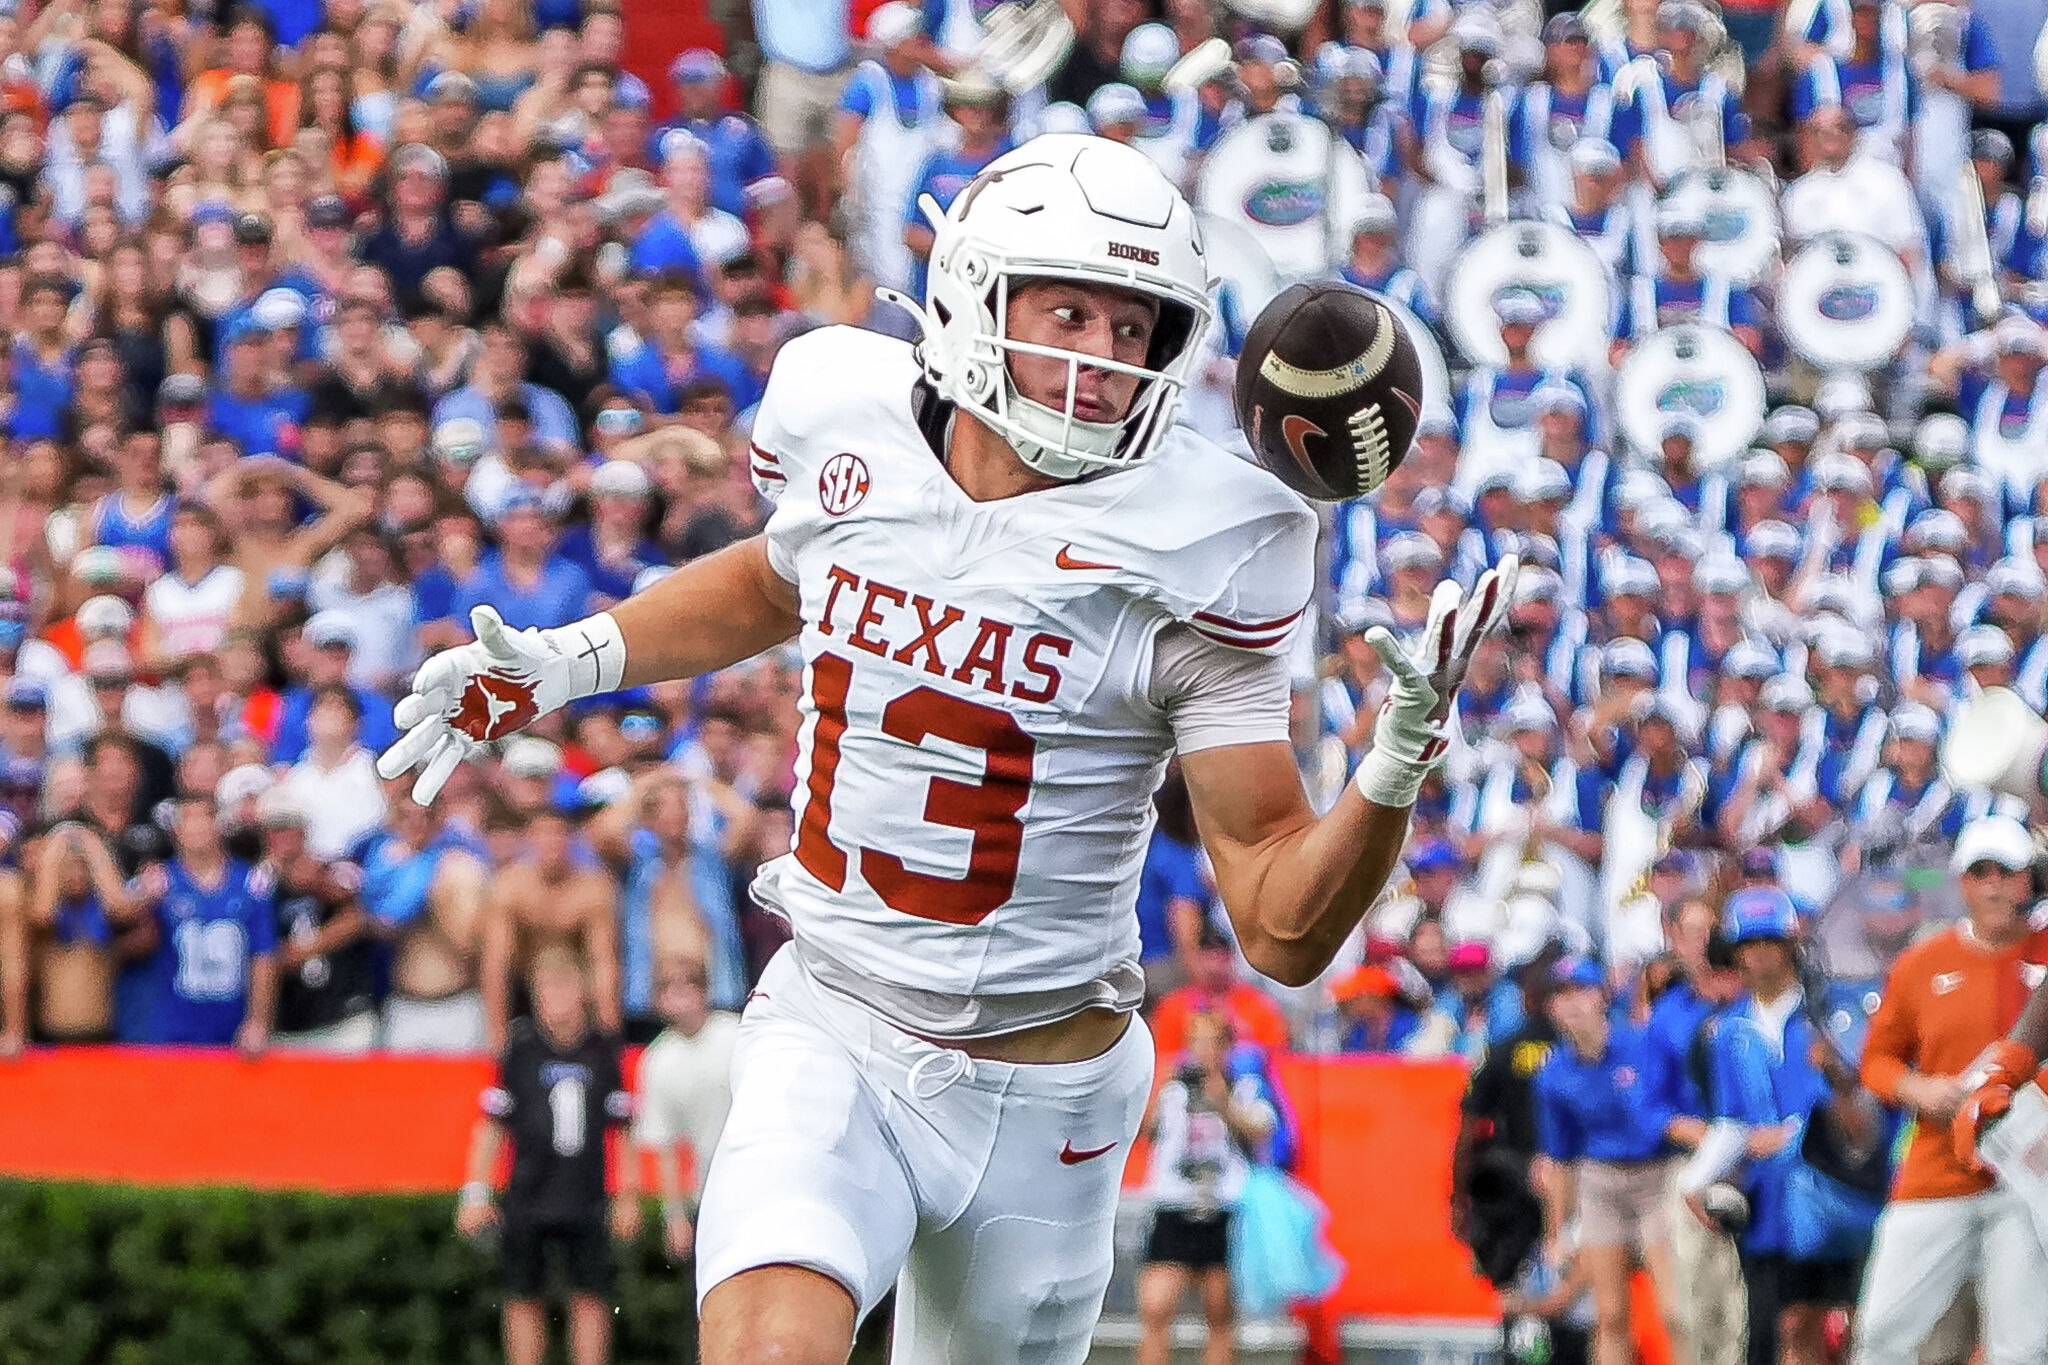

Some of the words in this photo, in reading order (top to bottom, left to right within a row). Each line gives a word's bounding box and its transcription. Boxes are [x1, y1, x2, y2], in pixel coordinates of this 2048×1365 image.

[1107, 241, 1160, 266] HORNS
[819, 453, 870, 516] SEC
[818, 564, 1073, 705] TEXAS
[794, 651, 1036, 926] 13
[549, 1077, 586, 1157] 1
